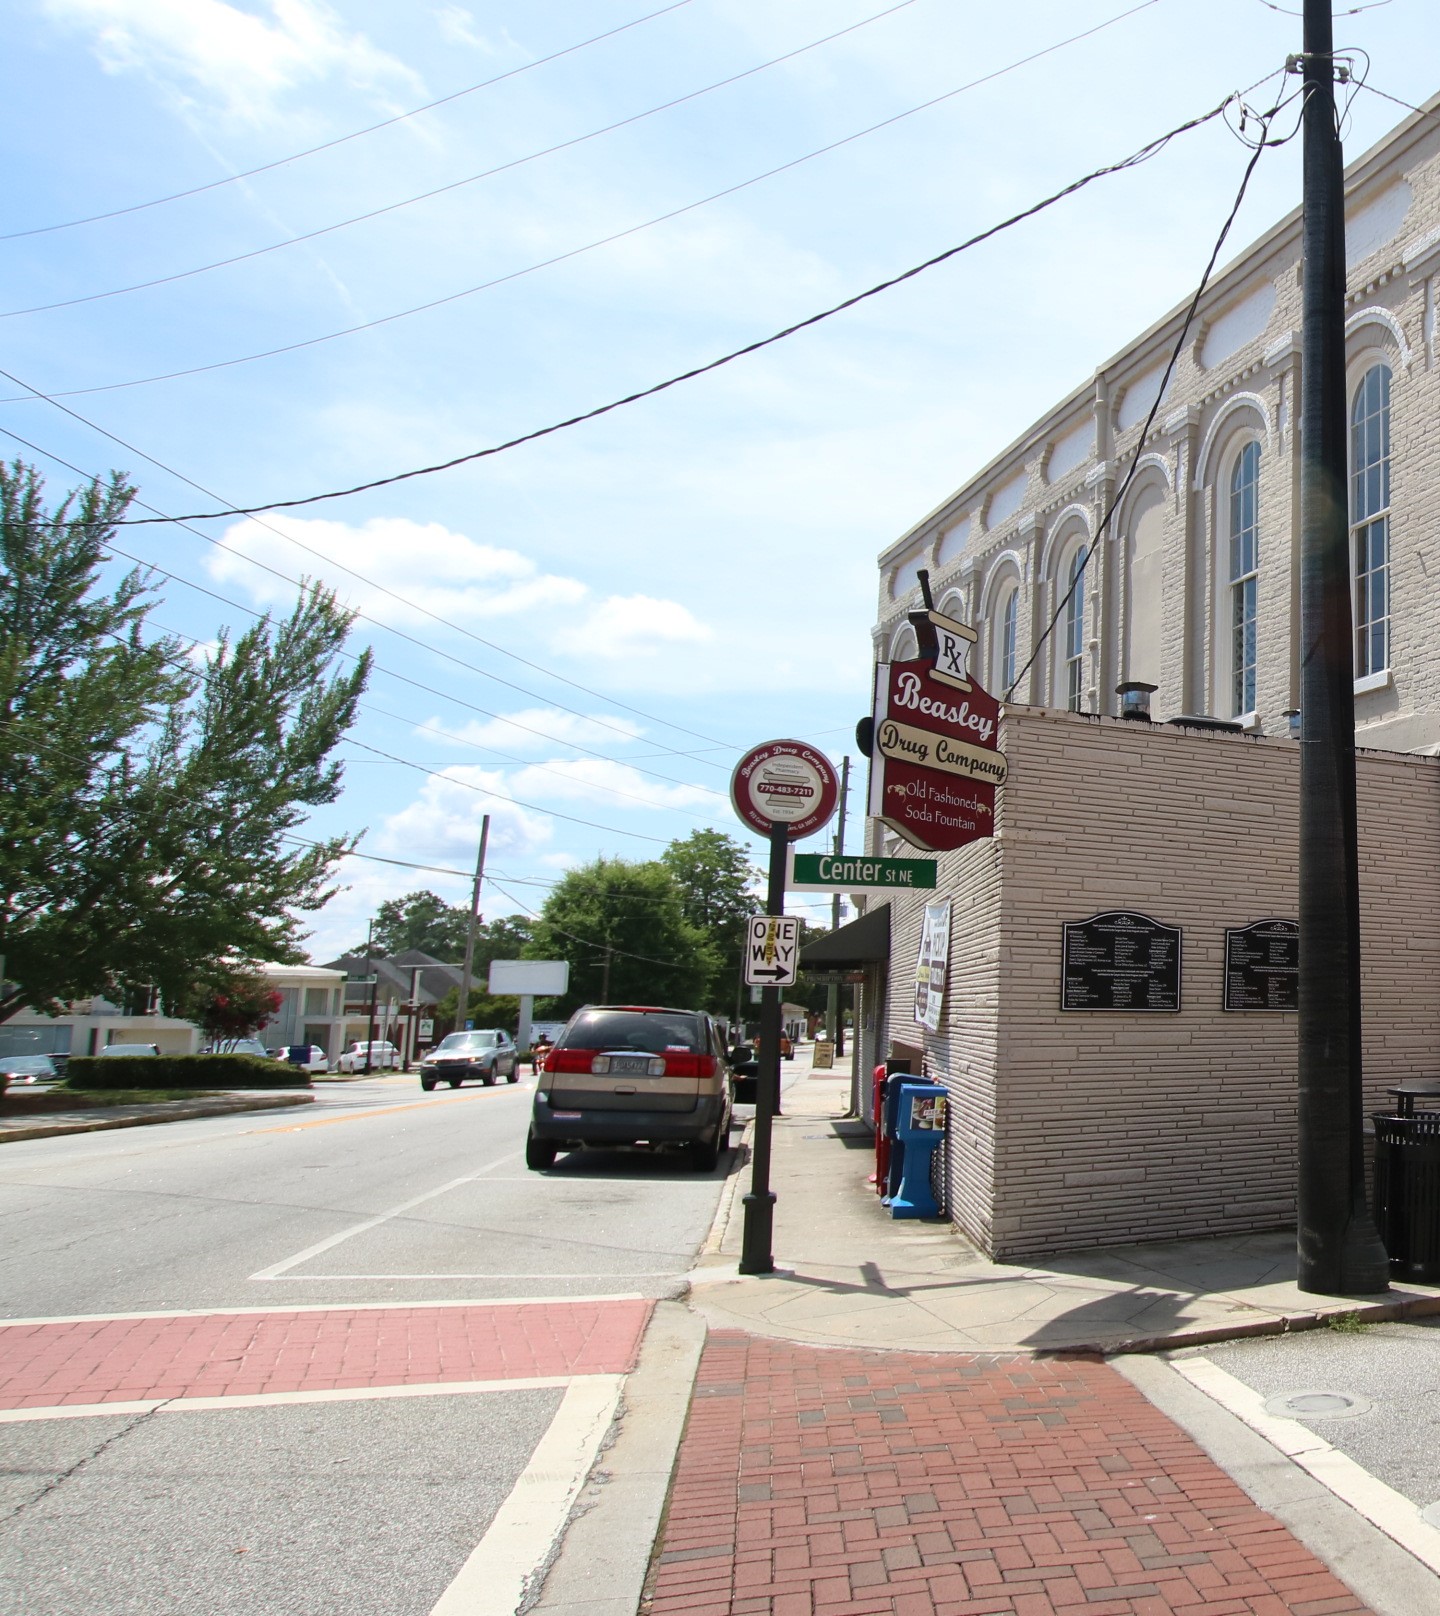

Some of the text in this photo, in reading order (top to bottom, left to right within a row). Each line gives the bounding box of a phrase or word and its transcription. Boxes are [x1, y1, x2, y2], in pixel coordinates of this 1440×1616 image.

[893, 671, 995, 741] Beasley
[741, 745, 830, 784] Beasley Drug Company
[881, 724, 1006, 782] Drug Company
[759, 784, 812, 796] 770-483-7211
[906, 779, 977, 811] Old Fashioned
[755, 815, 769, 827] Center
[904, 803, 976, 831] Soda Fountain
[818, 856, 914, 883] Center St NE
[754, 921, 795, 940] ONE
[753, 944, 794, 962] WAY
